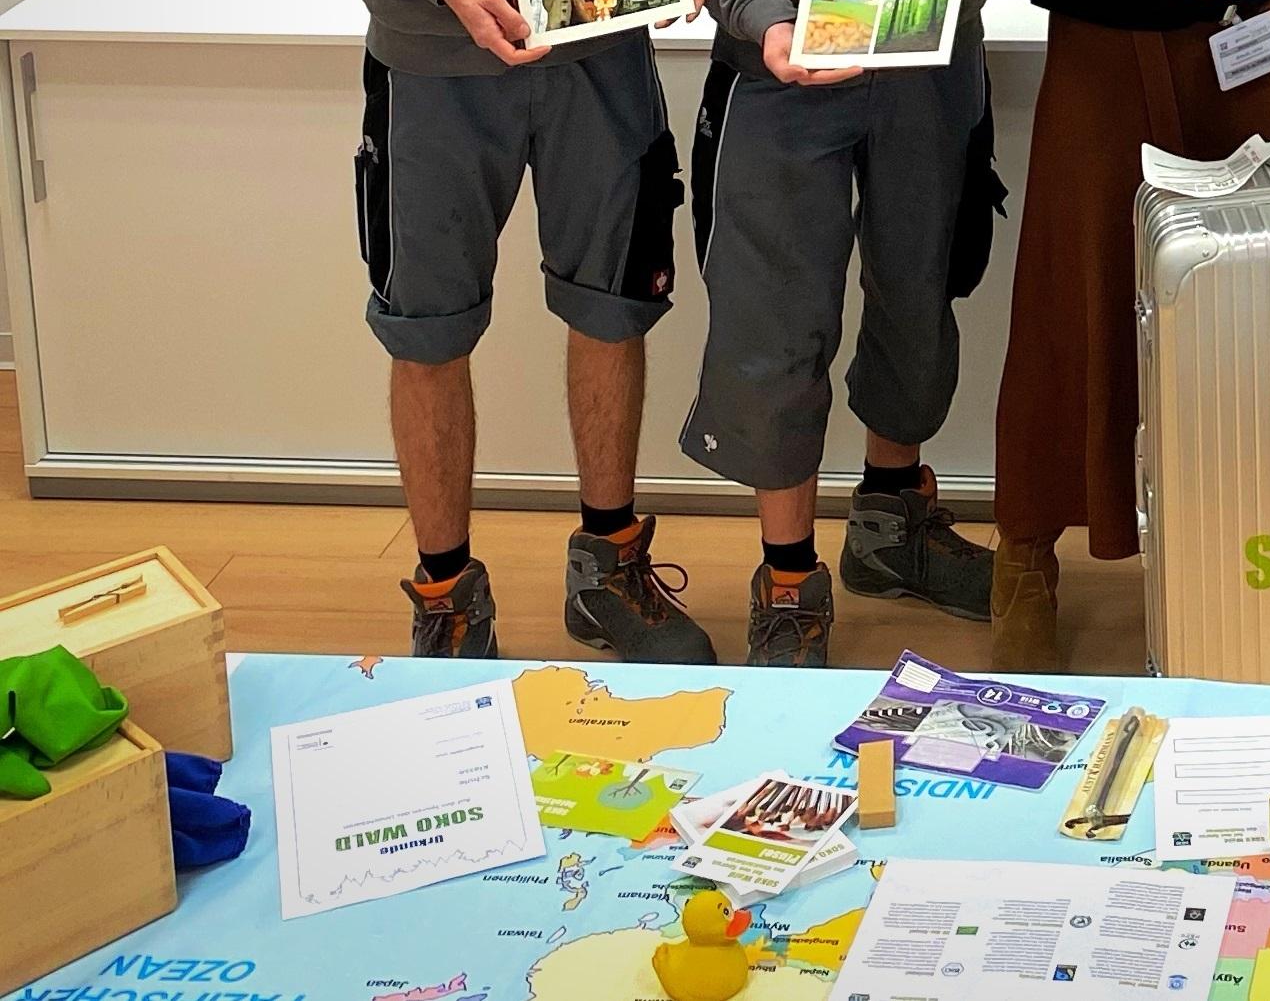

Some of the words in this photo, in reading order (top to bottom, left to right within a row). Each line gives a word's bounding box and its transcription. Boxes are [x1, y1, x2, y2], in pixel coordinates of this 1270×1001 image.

[568, 718, 631, 727] Australien
[416, 806, 484, 833] SOKO
[335, 824, 408, 852] WALD
[380, 835, 444, 856] Urkunde
[1100, 856, 1152, 867] Somalia
[1200, 859, 1250, 870] Uganda
[754, 877, 780, 888] SOKO
[617, 892, 670, 901] Vietnam
[497, 929, 544, 939] Taiwan
[98, 954, 256, 984] OZEAN
[366, 979, 409, 990] Japan
